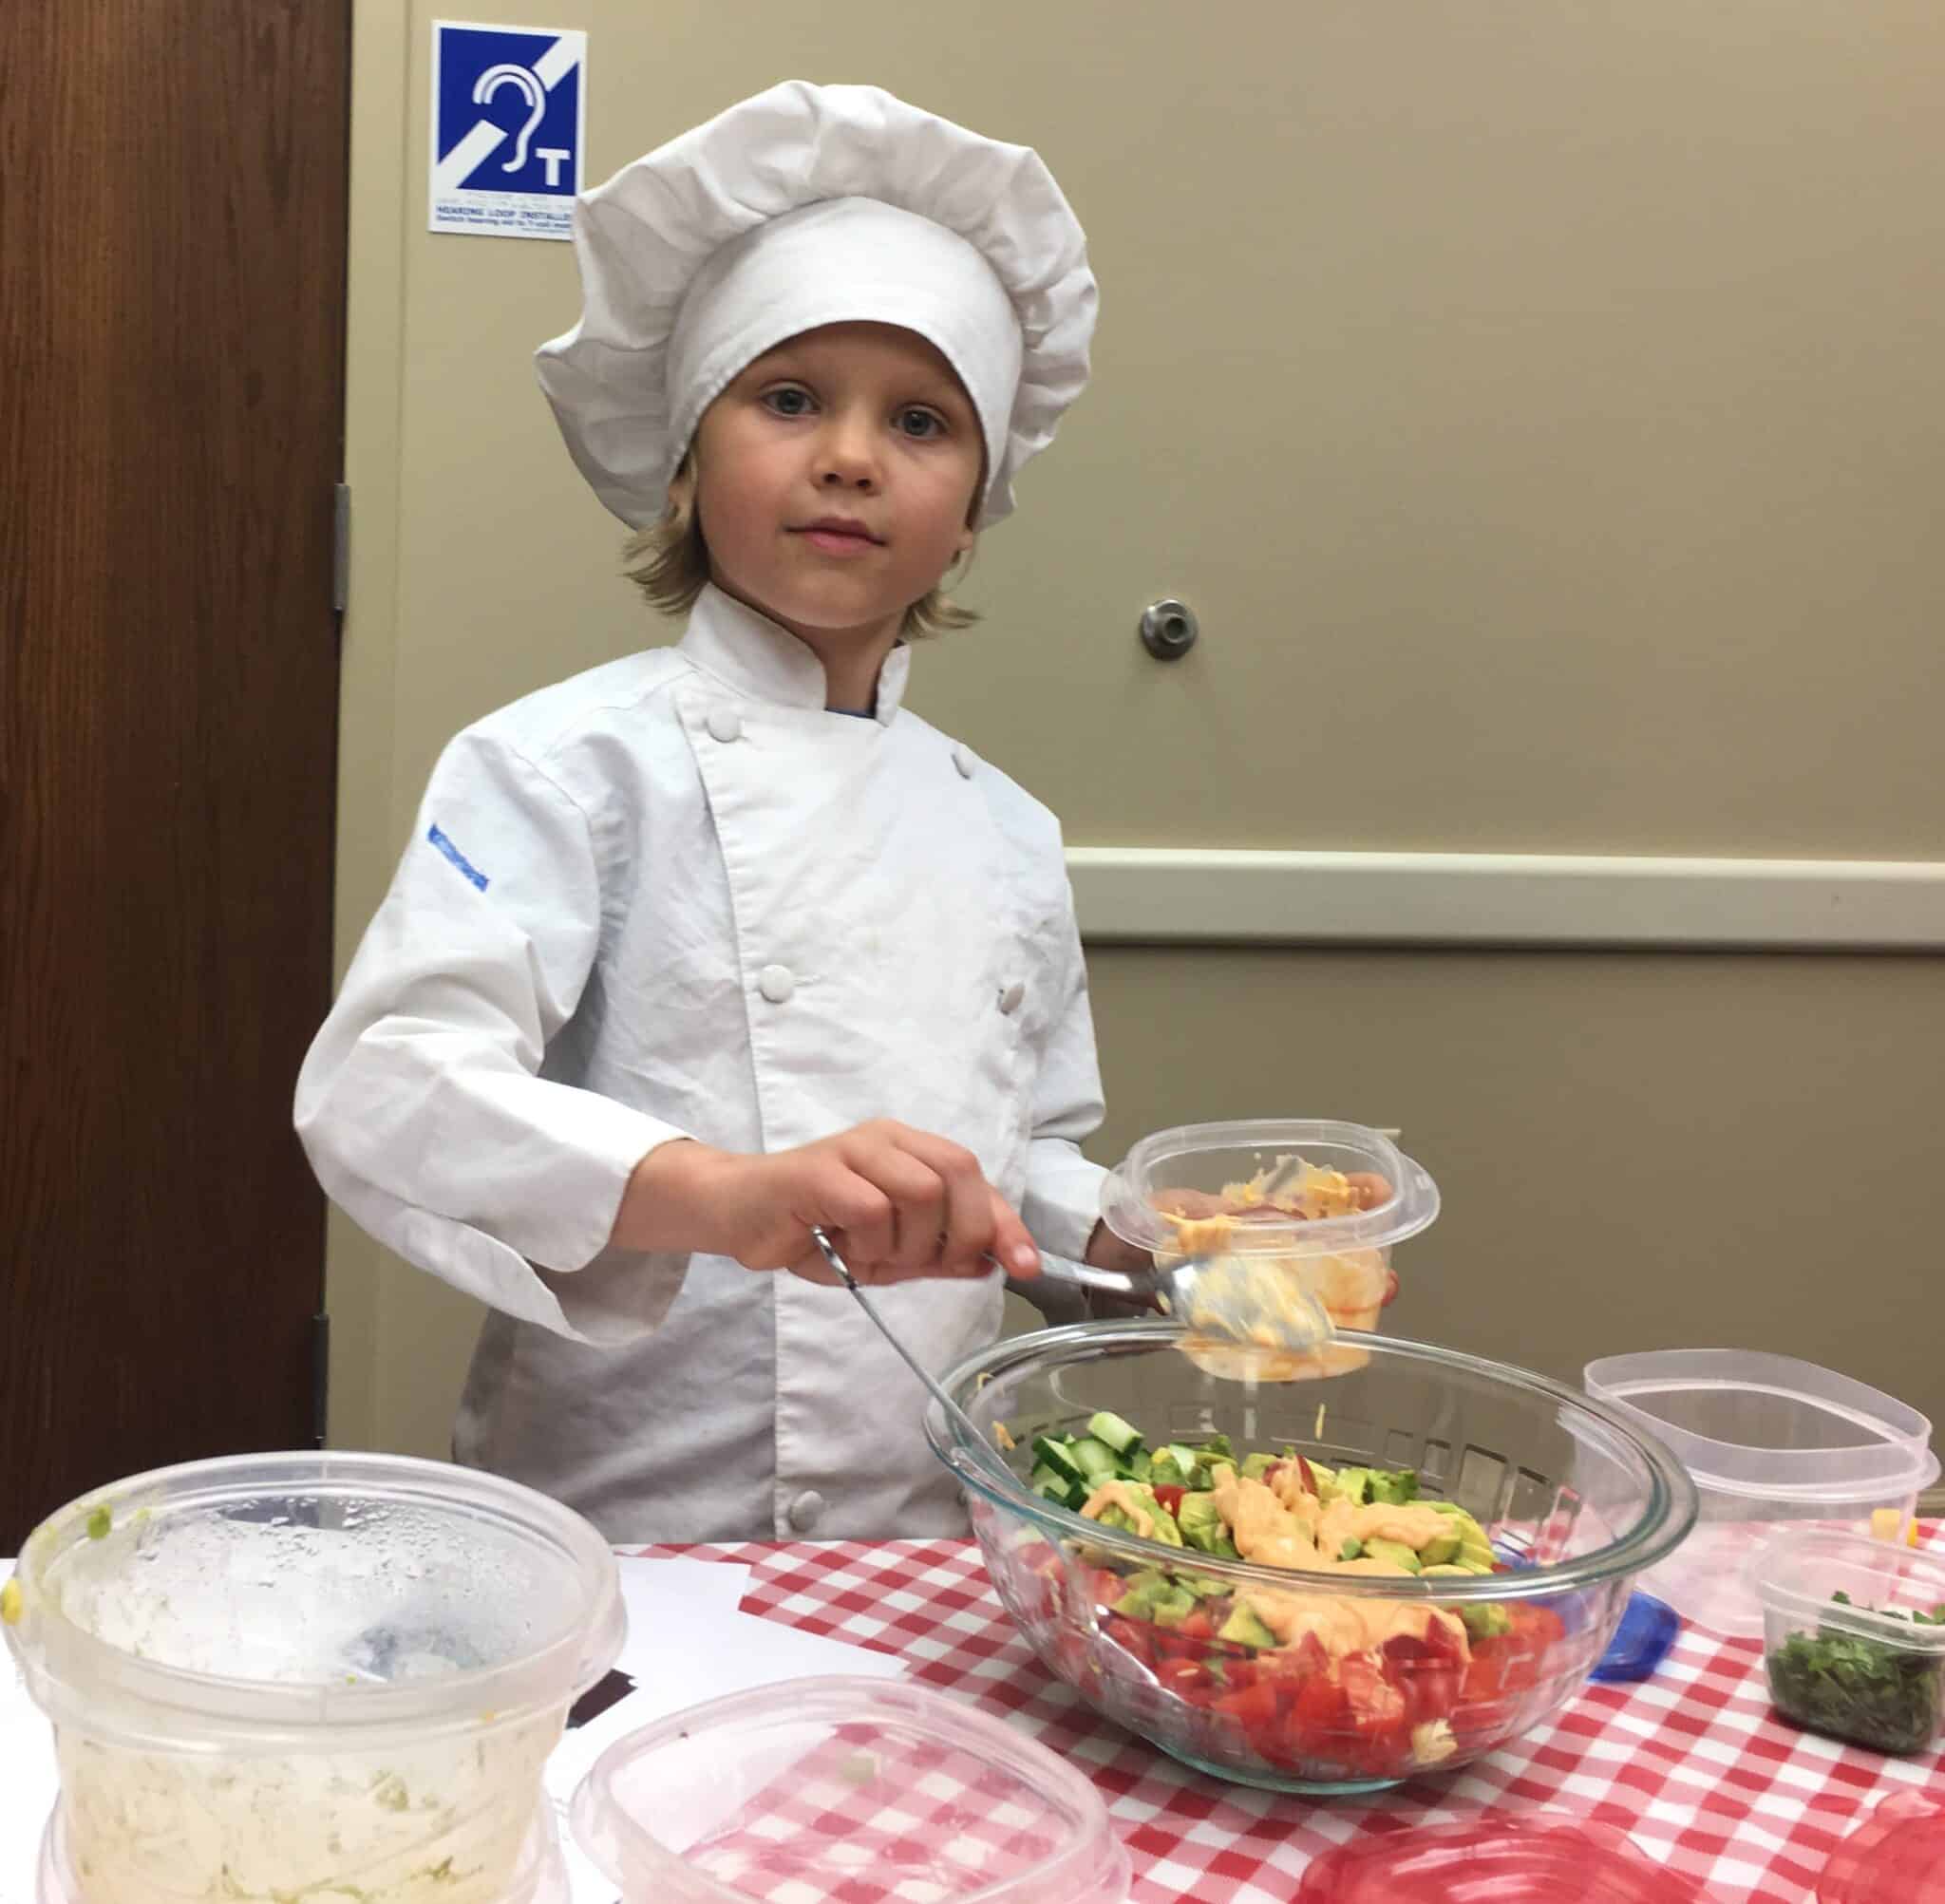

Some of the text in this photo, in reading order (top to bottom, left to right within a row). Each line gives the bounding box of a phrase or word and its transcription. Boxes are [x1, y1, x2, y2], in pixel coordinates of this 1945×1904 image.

[536, 148, 570, 186] T
[437, 205, 571, 220] HEARING LOOP INSTALLE
